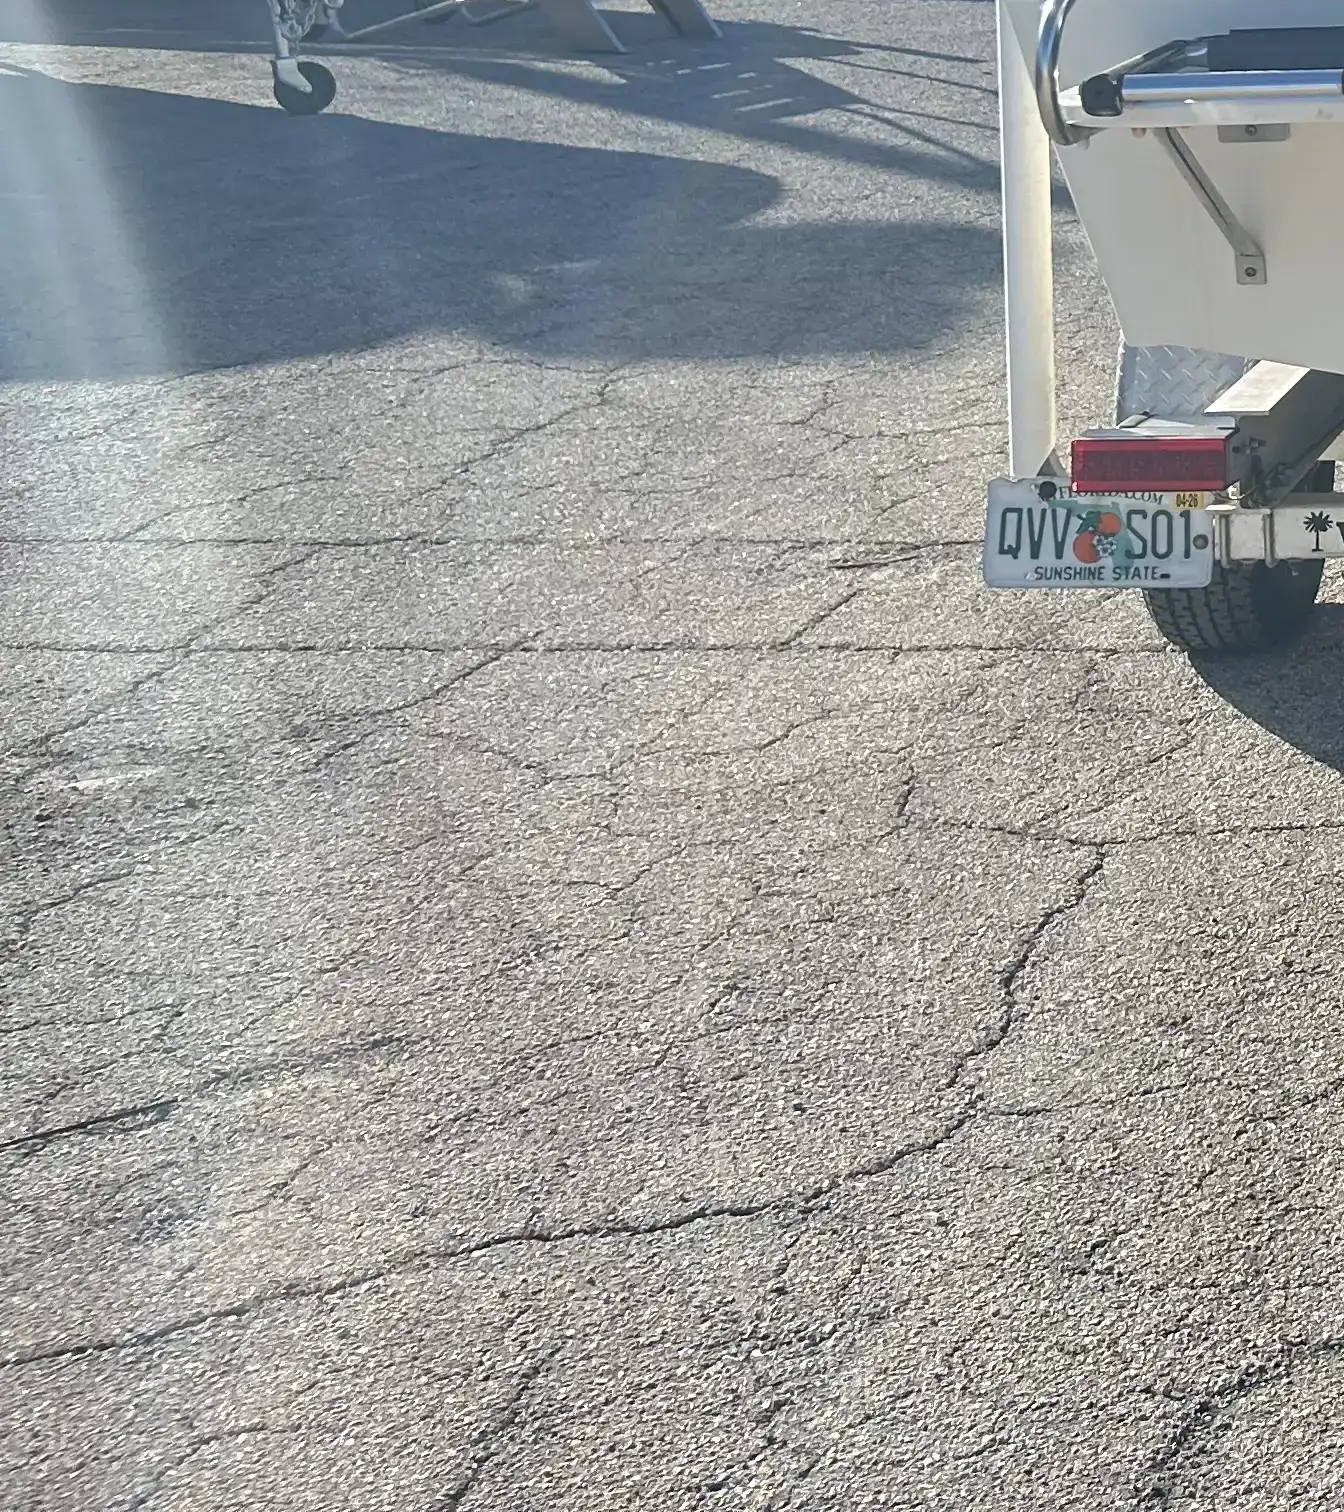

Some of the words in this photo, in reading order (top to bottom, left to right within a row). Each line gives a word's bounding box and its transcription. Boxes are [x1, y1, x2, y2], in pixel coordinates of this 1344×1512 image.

[1175, 493, 1199, 508] 04-26
[998, 507, 1074, 560] QVV
[1034, 566, 1105, 581] SUNSHINE
[1112, 566, 1160, 581] STATE
